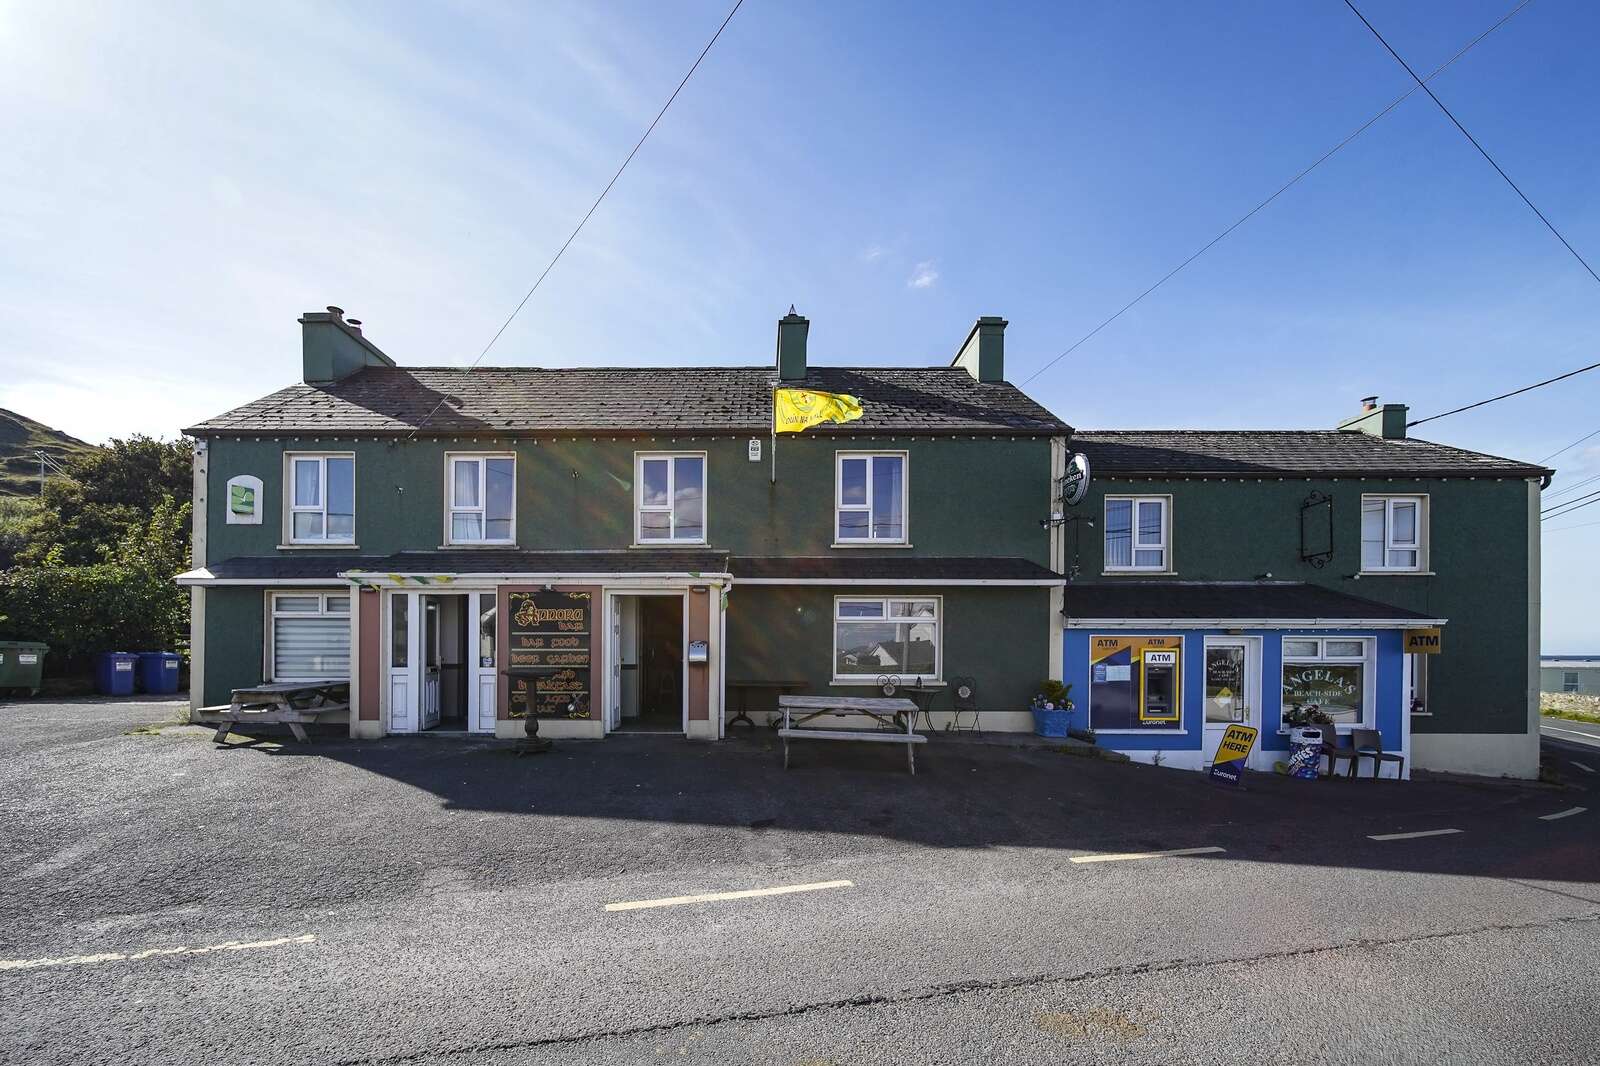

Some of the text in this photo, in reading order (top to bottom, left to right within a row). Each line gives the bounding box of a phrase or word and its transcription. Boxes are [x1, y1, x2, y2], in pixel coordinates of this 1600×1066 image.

[1097, 639, 1119, 648] ATM
[1409, 636, 1439, 647] ATM
[1150, 654, 1171, 662] ATM
[1282, 669, 1356, 696] ANGELA'S
[1227, 729, 1253, 743] ATM
[1222, 741, 1249, 754] HERE
